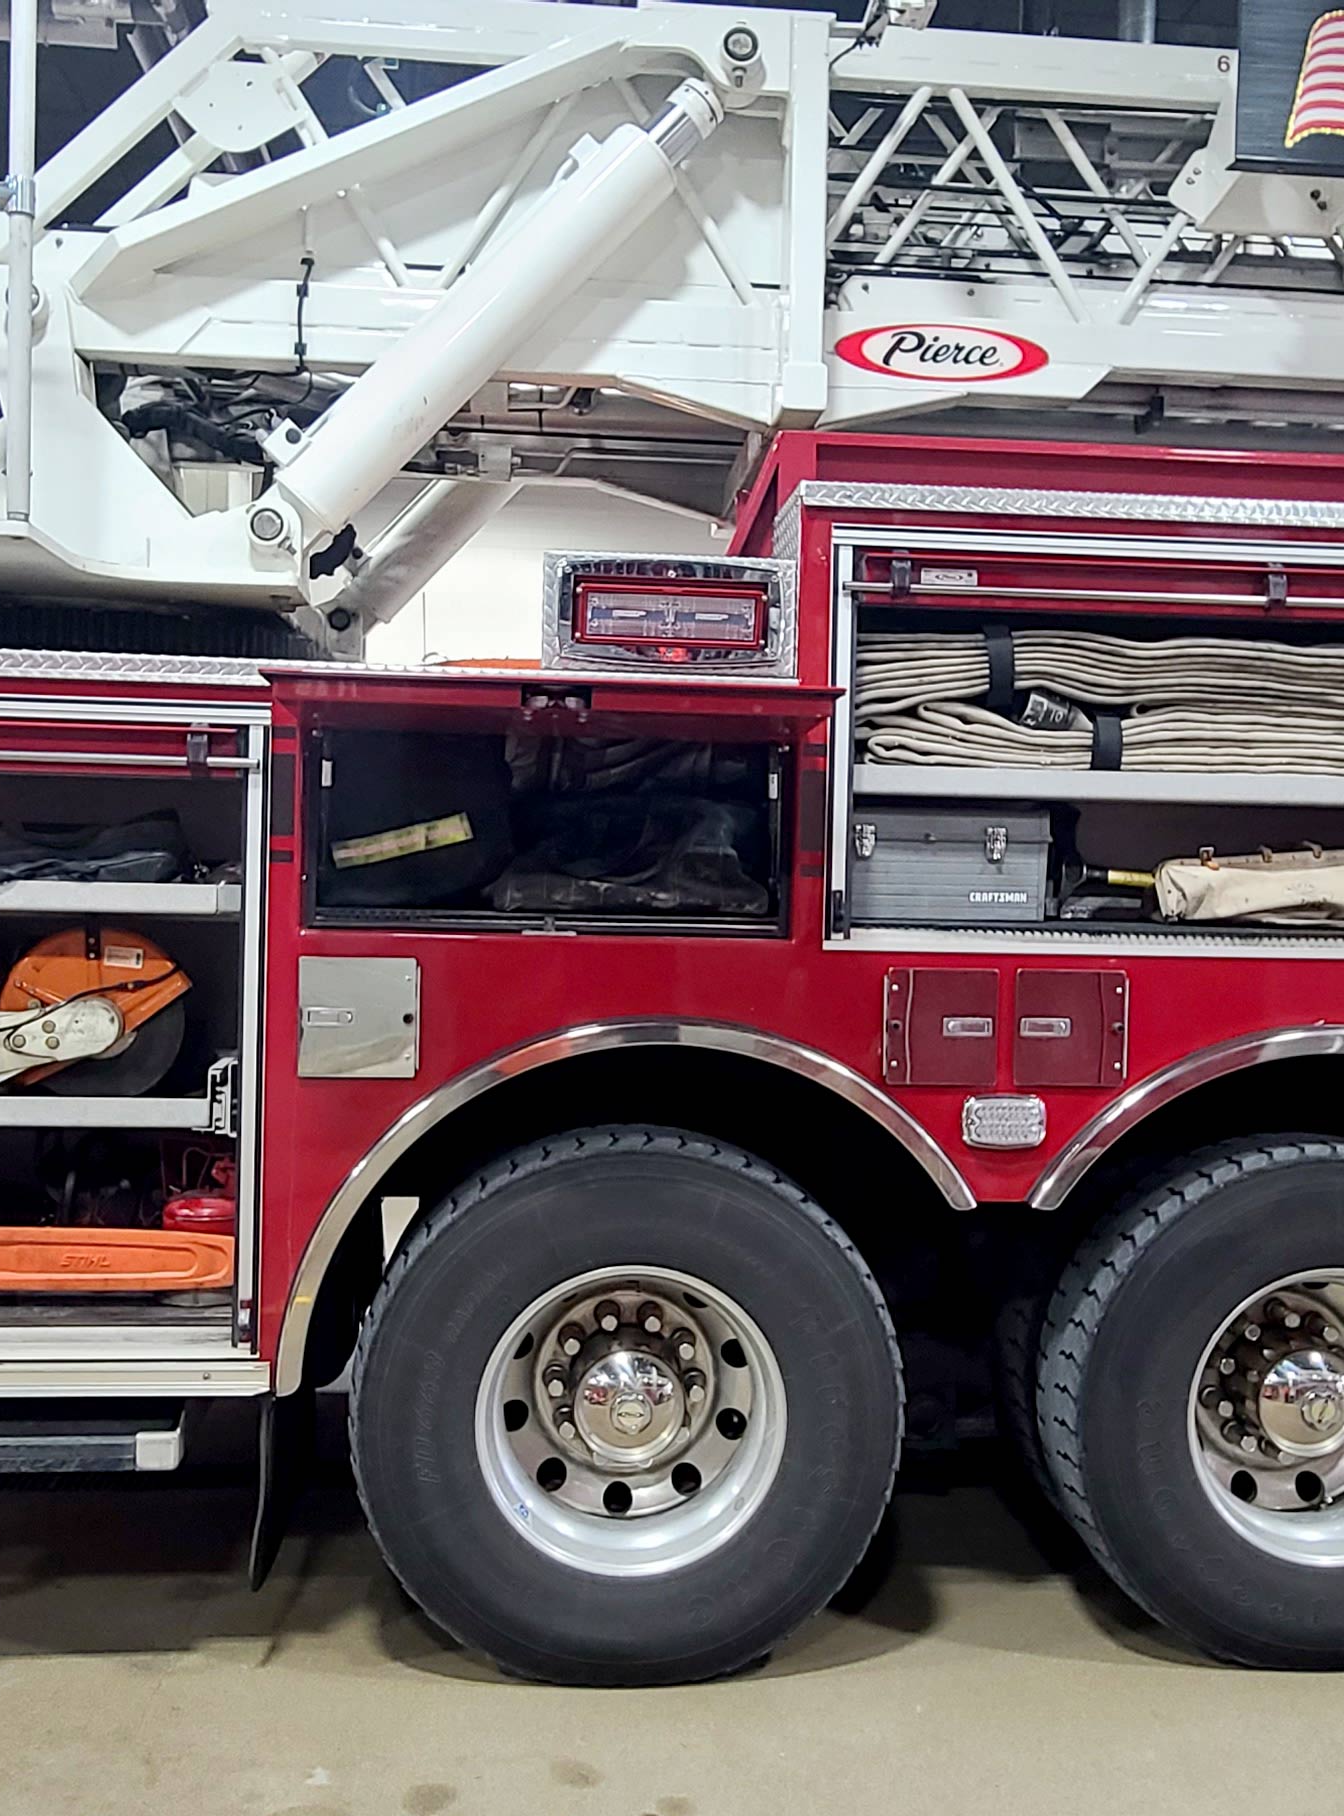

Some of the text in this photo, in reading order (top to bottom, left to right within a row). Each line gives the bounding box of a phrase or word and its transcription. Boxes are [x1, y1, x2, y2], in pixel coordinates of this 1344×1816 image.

[1217, 54, 1231, 73] 6
[882, 330, 1000, 367] Pierce
[968, 891, 1028, 903] CRAFTSMAN
[60, 1255, 110, 1268] STIHL
